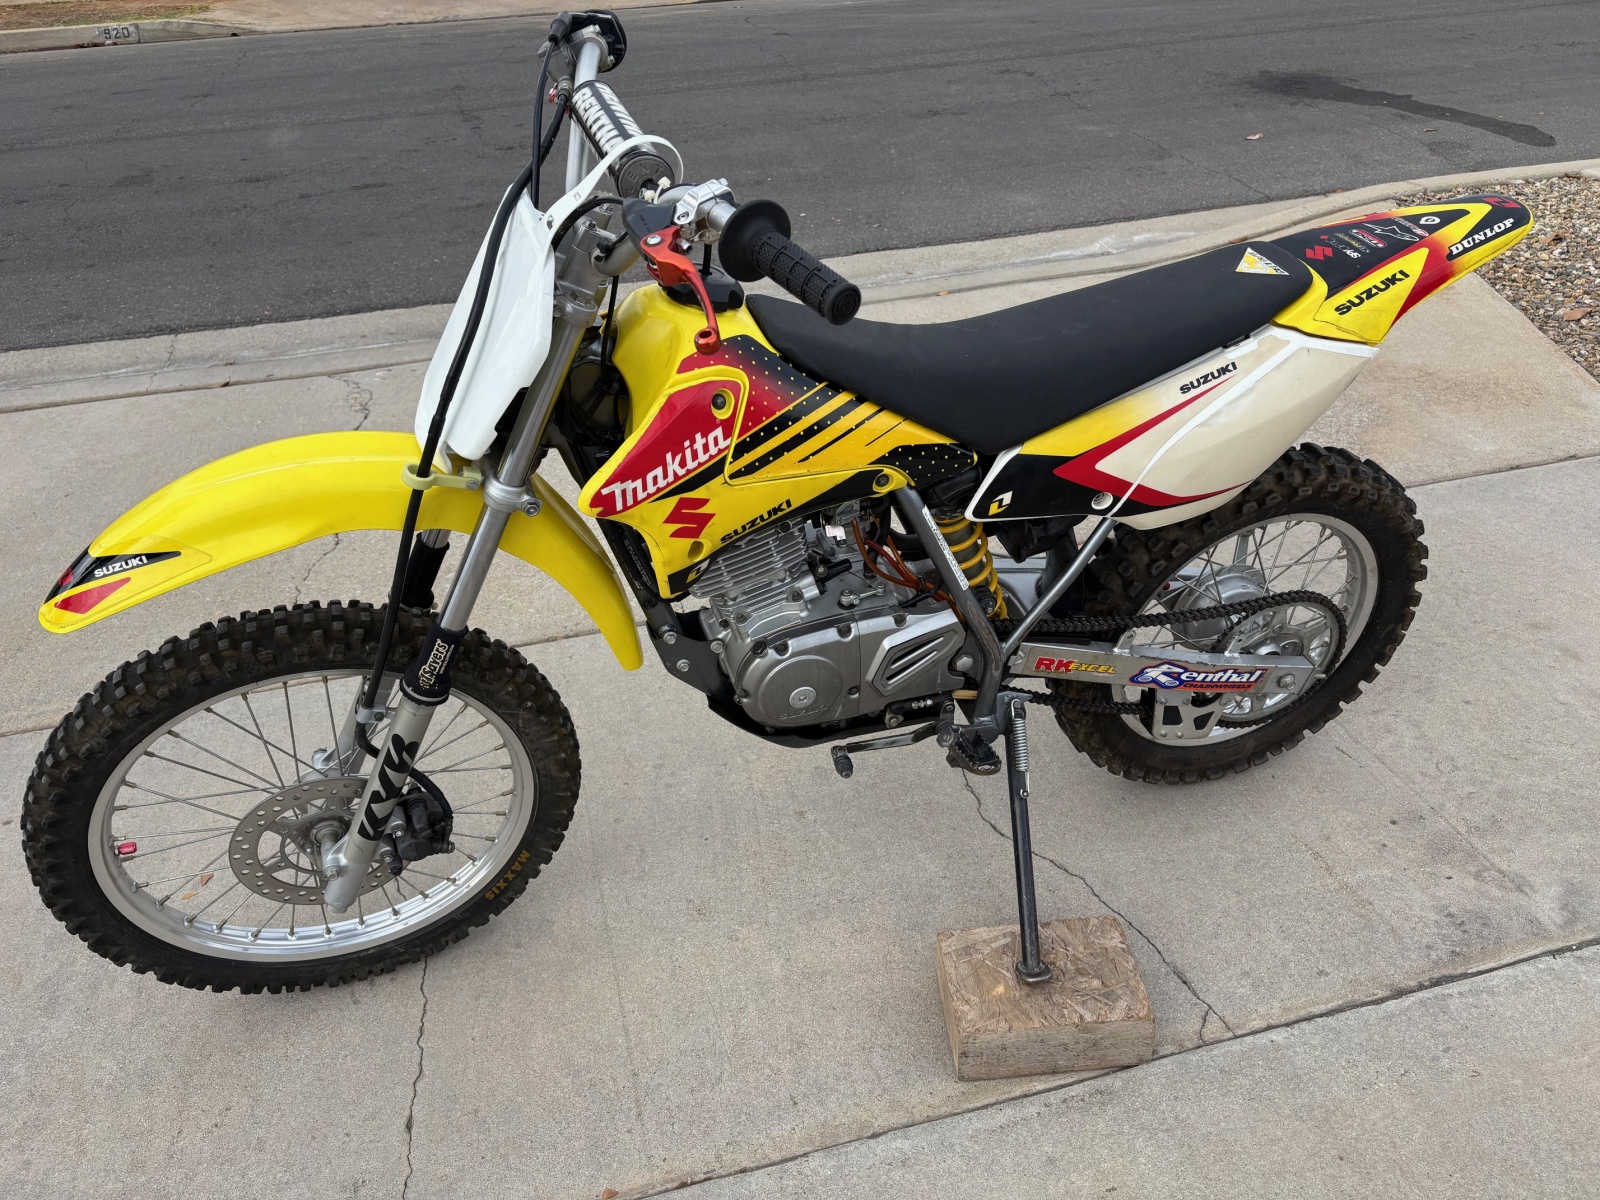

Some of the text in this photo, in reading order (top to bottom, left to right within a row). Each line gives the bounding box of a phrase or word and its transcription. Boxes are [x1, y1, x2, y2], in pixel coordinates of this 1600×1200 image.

[103, 27, 130, 40] 920
[572, 86, 626, 156] RENTHA
[1450, 217, 1515, 256] DUNLOP
[1334, 269, 1411, 316] SUZUKI
[1179, 361, 1238, 394] SUZUKI
[720, 498, 793, 545] SUZUKI
[93, 554, 148, 578] SUZUKI
[1033, 656, 1118, 675] RK EXCEL
[1182, 681, 1254, 690] CHAINWHEELS
[484, 849, 531, 901] MAXXIS
